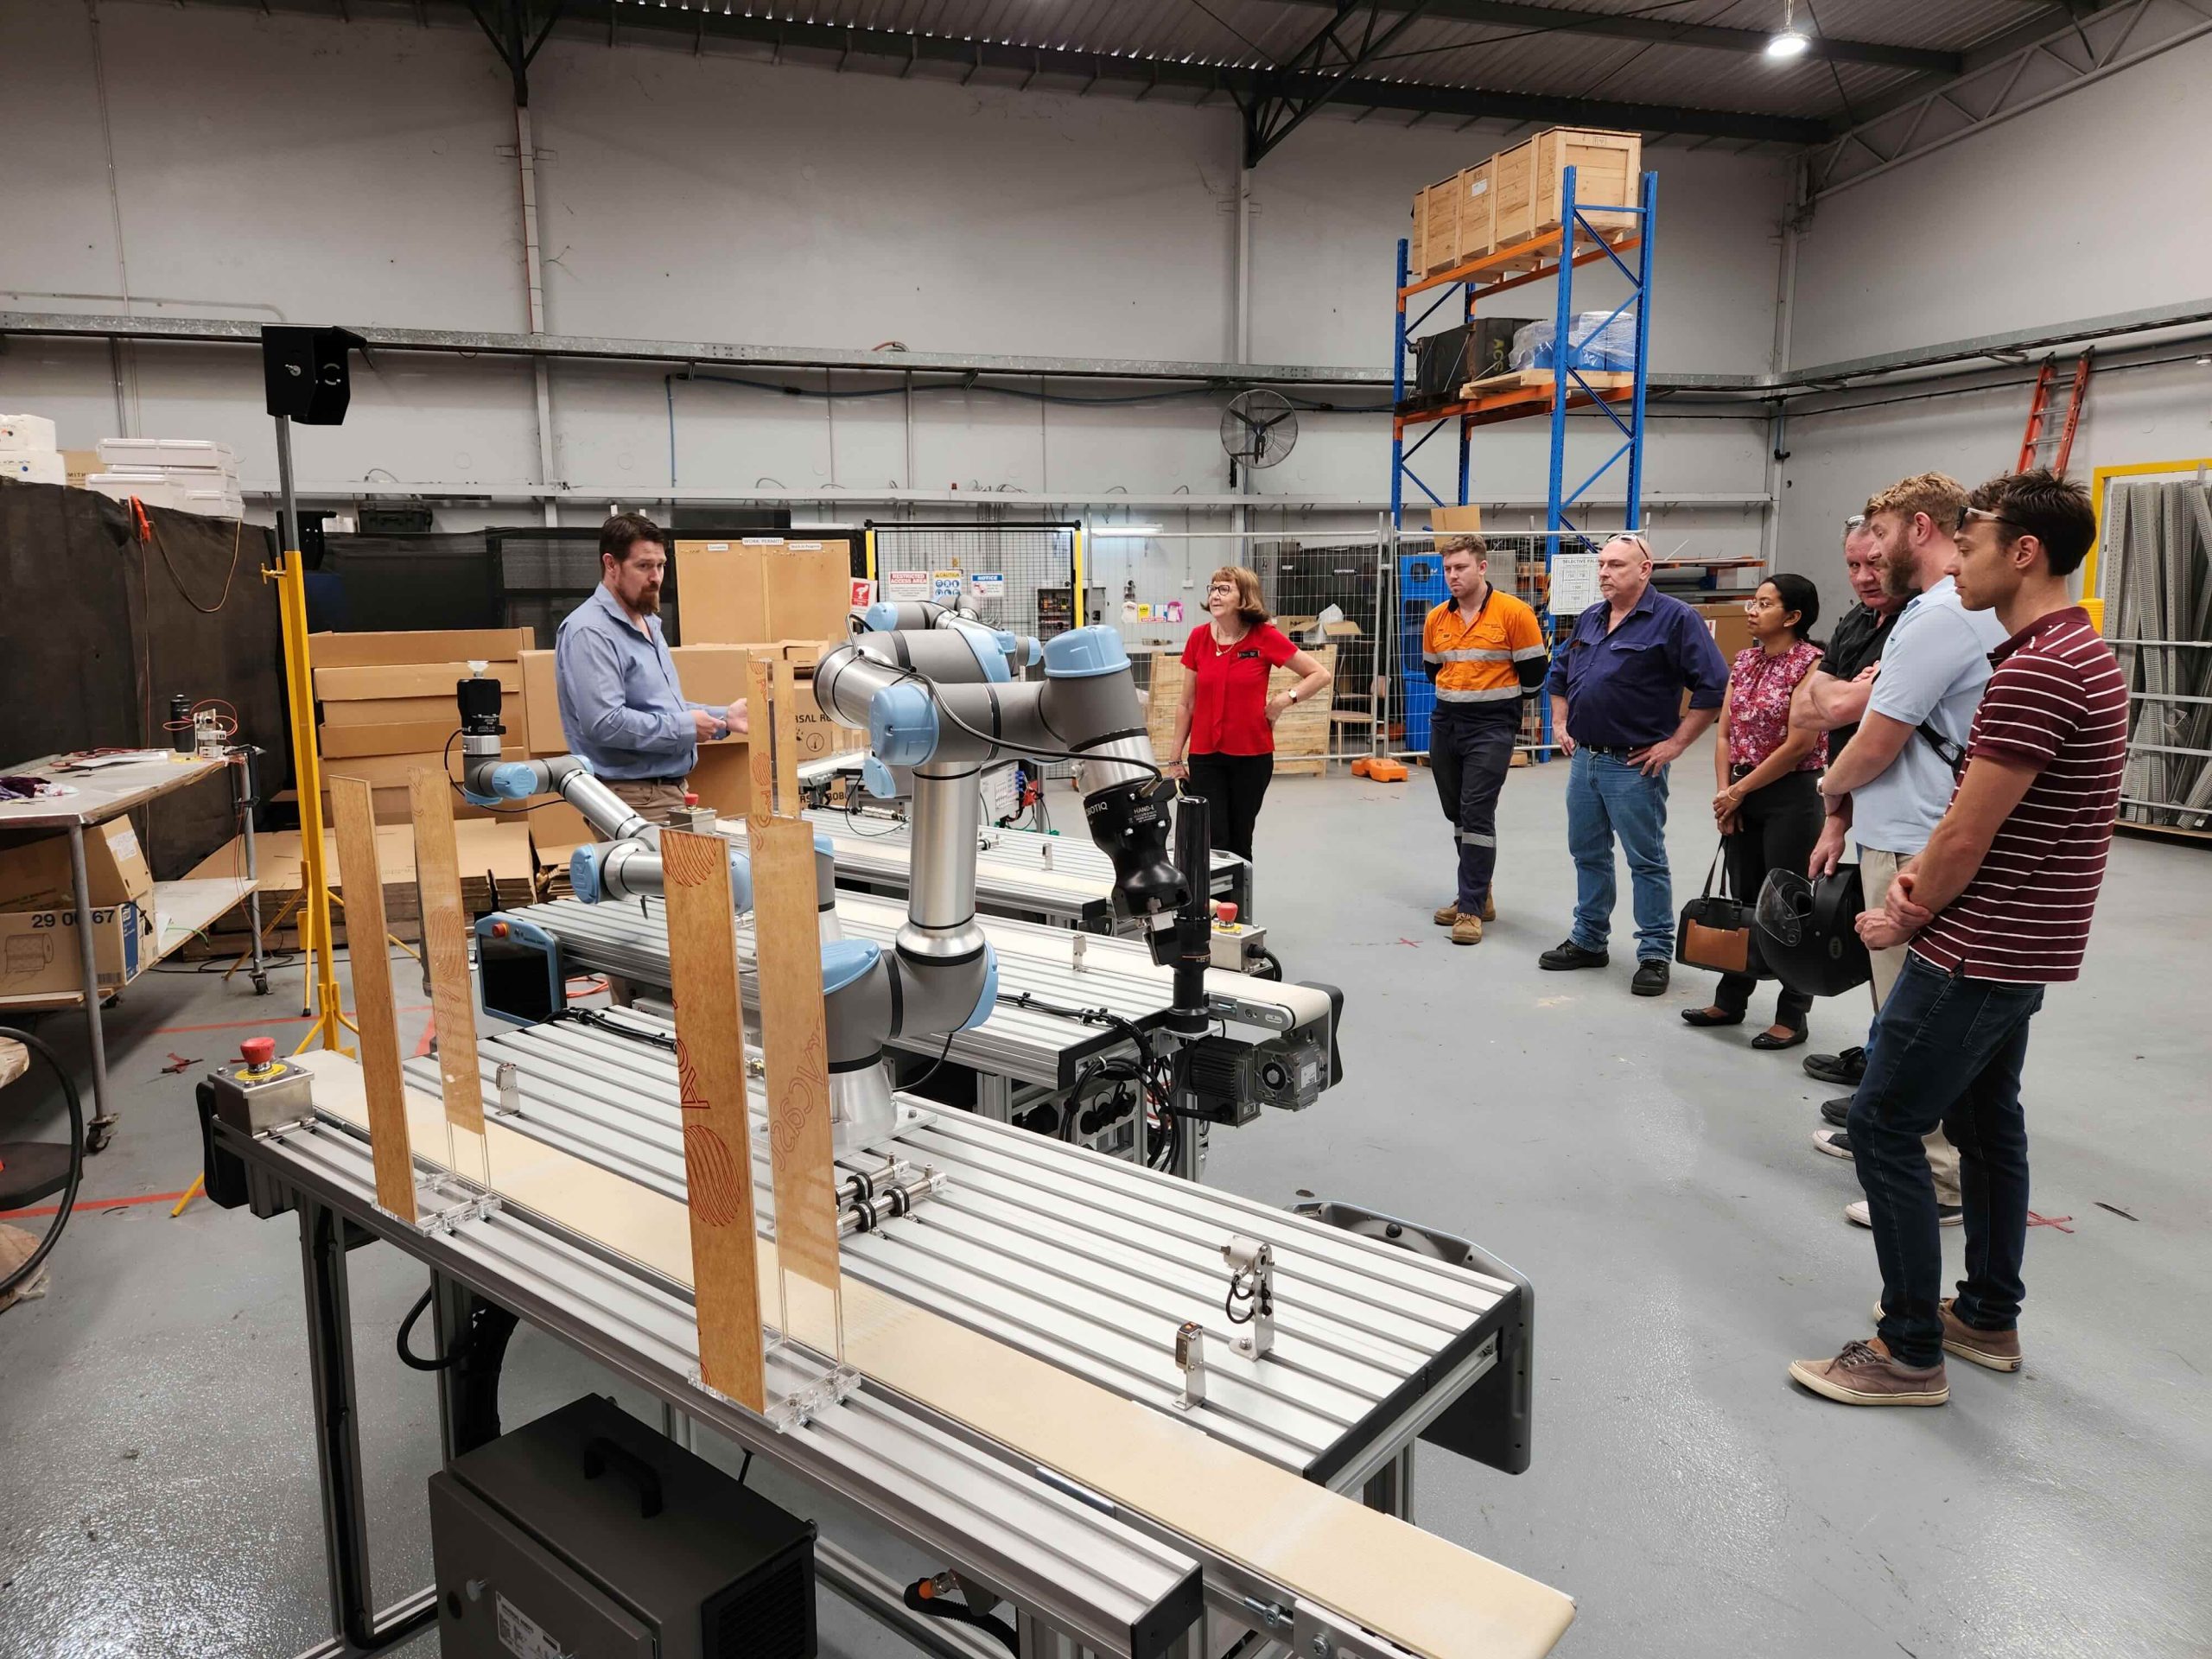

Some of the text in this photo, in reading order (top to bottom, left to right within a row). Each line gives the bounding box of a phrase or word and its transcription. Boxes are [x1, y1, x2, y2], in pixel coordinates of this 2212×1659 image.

[1134, 804, 1154, 814] HAND-E
[32, 913, 56, 929] 29
[92, 909, 115, 925] 67
